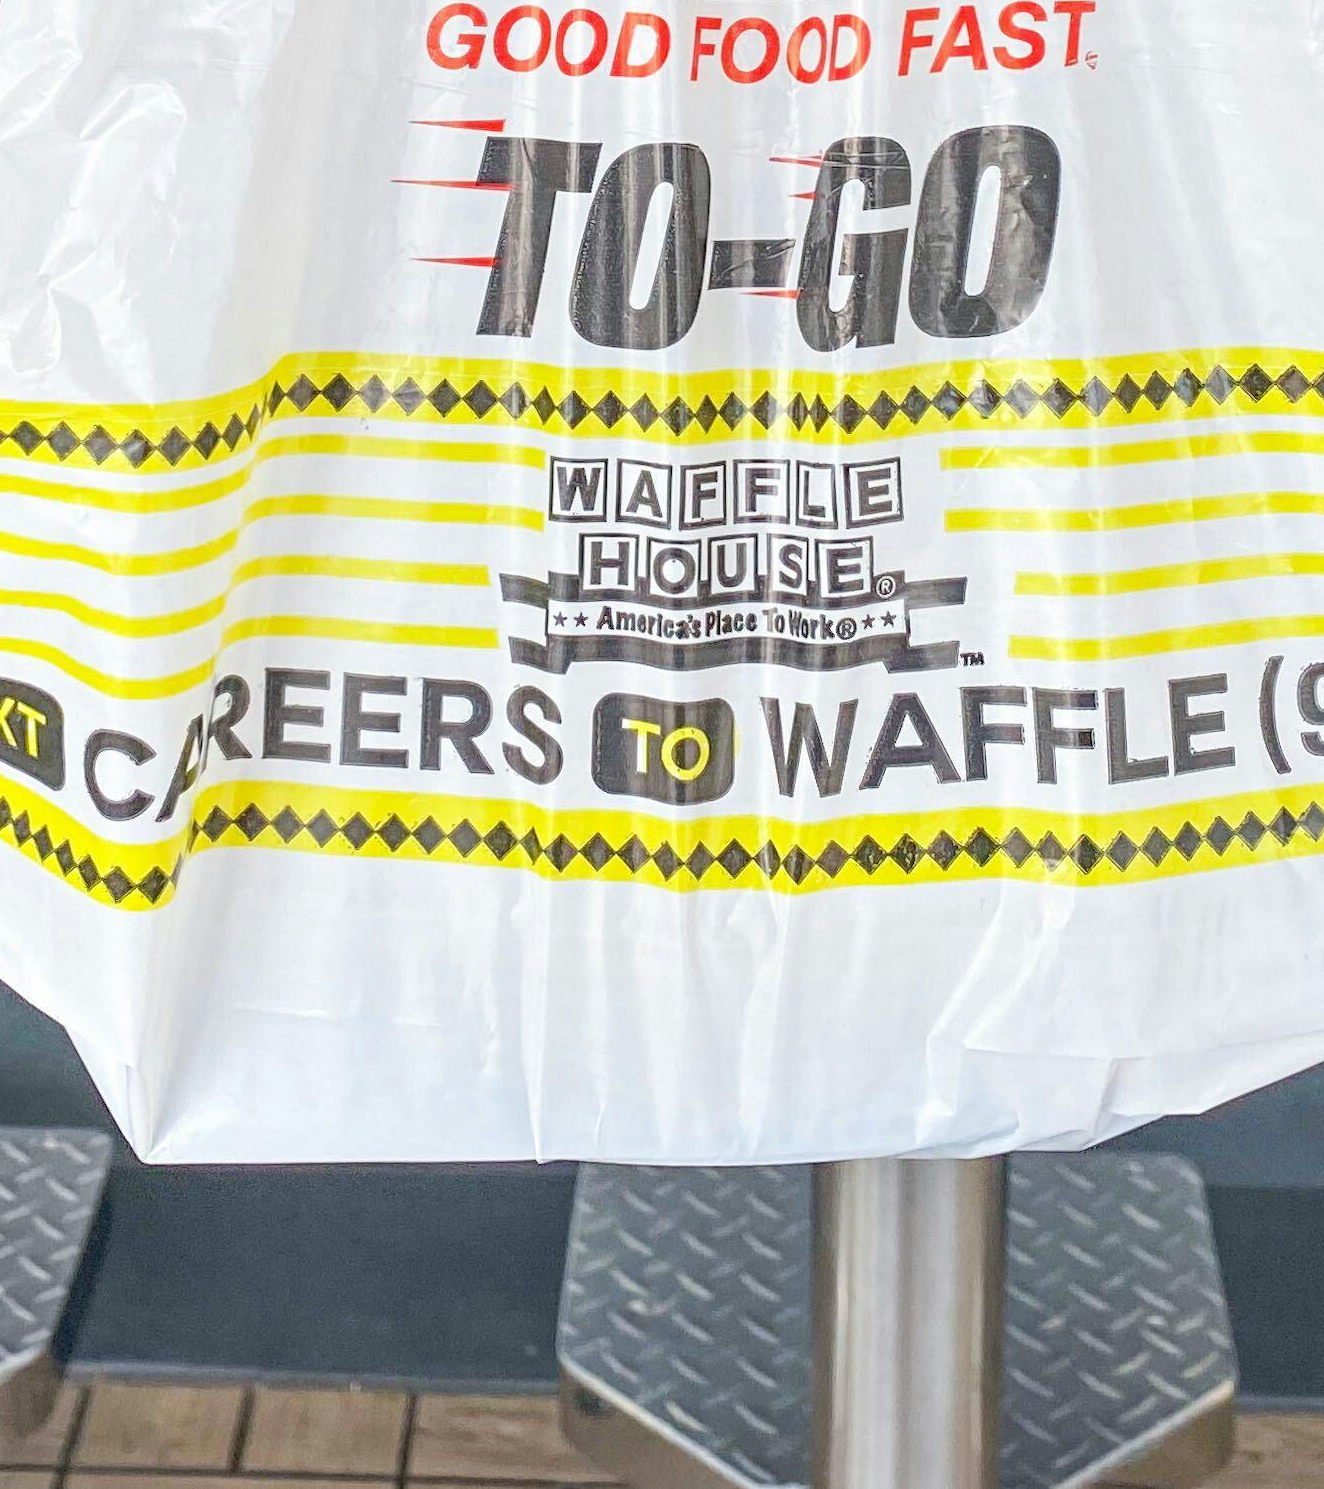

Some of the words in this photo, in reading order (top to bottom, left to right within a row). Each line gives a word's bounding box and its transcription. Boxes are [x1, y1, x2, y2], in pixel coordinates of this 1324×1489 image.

[426, 2, 671, 79] GOOD
[690, 13, 872, 85] FOOD
[898, 0, 1097, 78] FAST
[476, 124, 1063, 353] TO-GO
[556, 465, 894, 520] WAFFLE
[596, 605, 702, 640] America's
[705, 610, 758, 637] Place
[762, 608, 786, 634] To
[84, 666, 564, 823] CAREERS
[619, 718, 711, 782] TO
[761, 672, 1236, 798] WAFFLE
